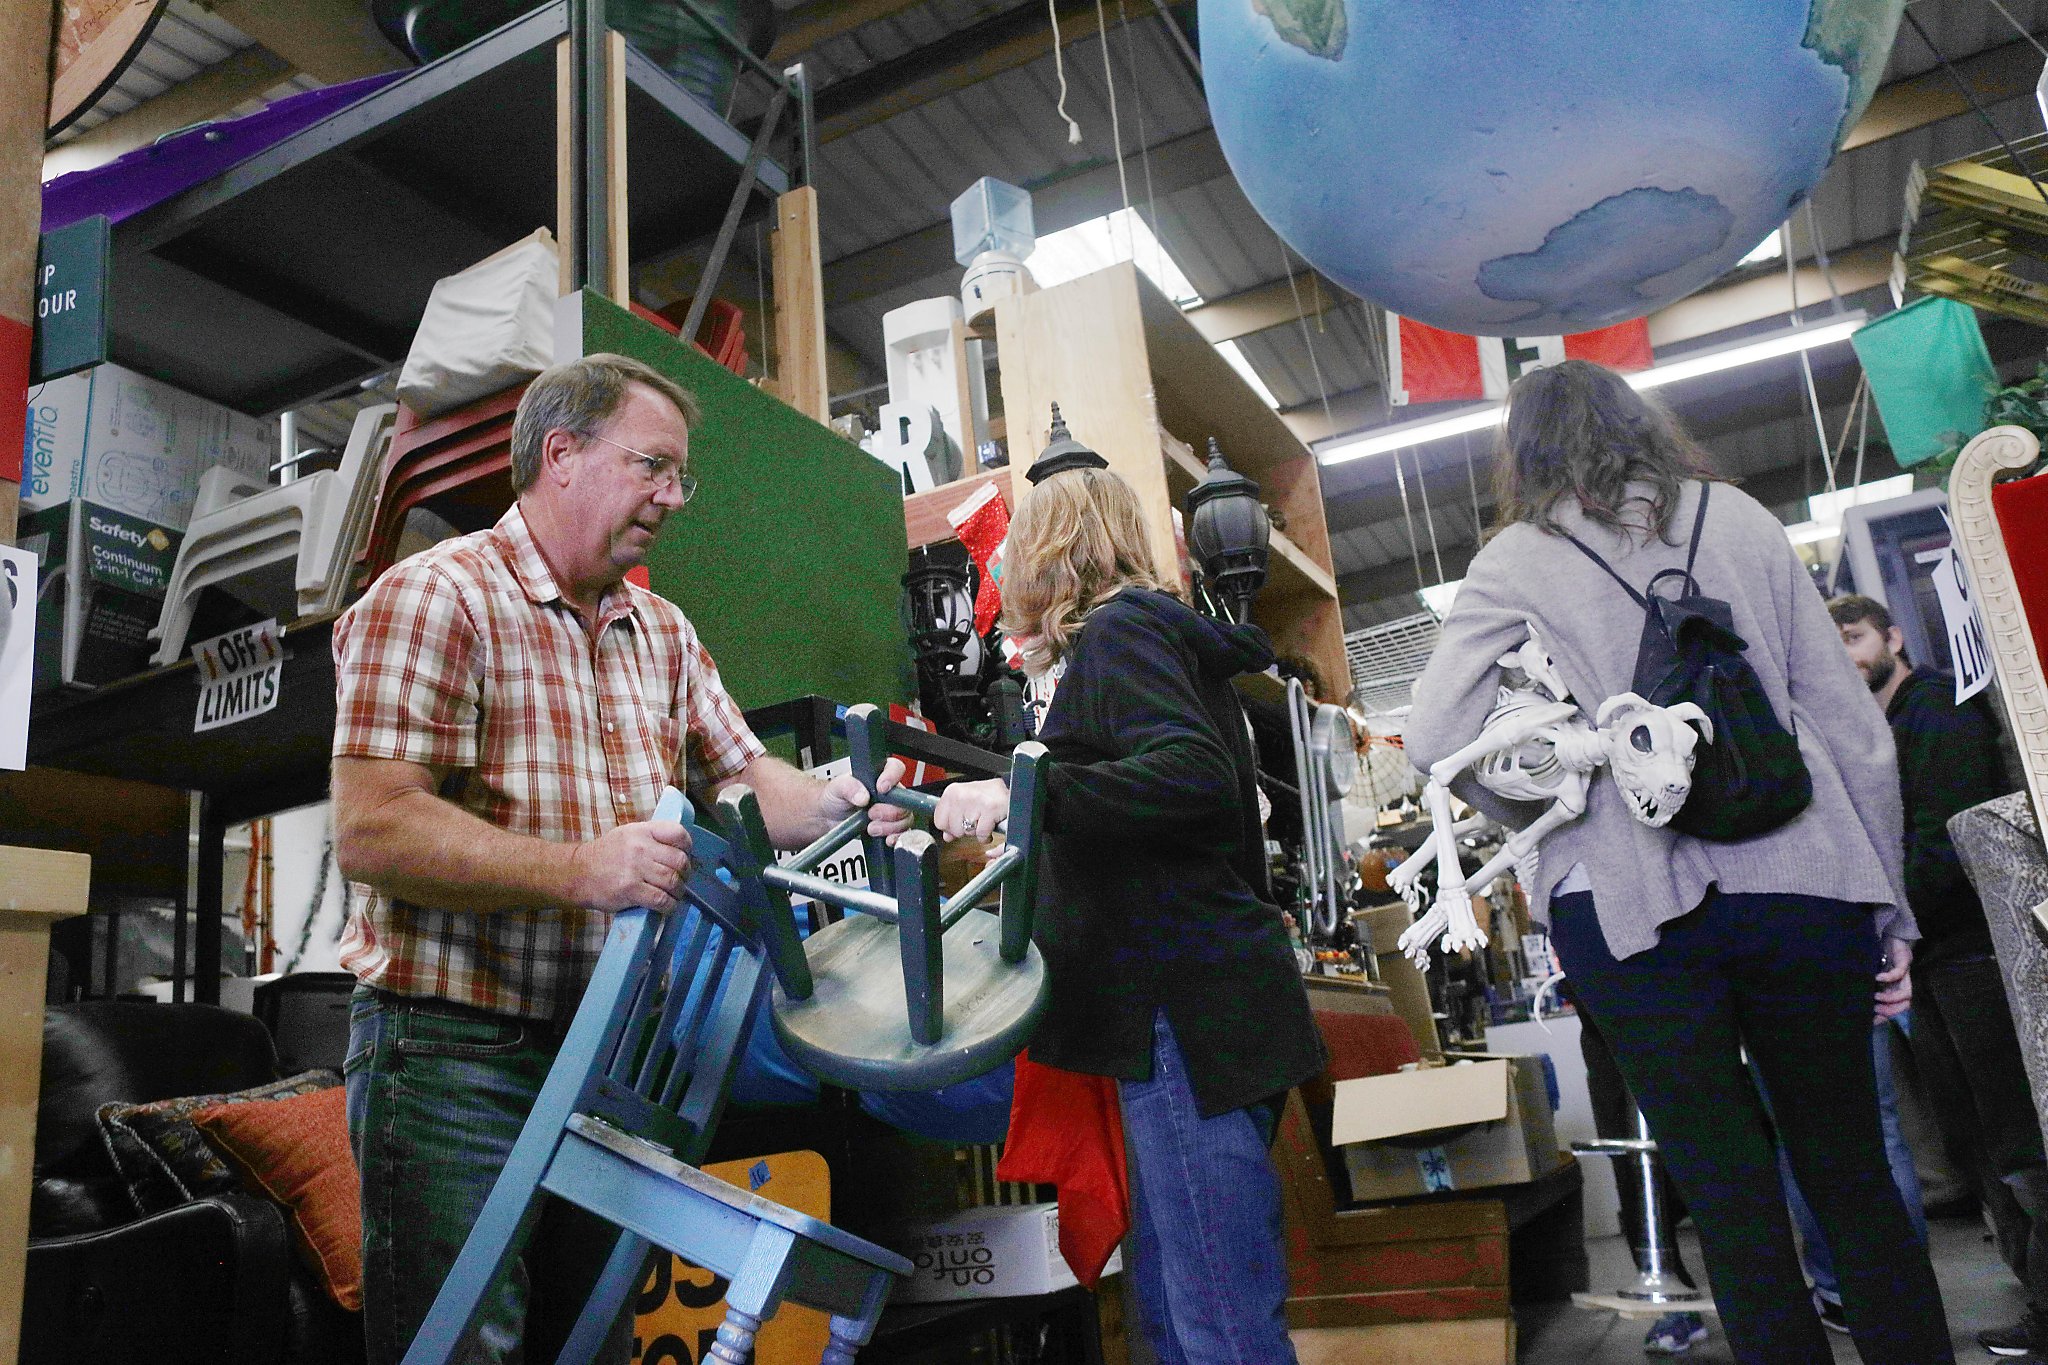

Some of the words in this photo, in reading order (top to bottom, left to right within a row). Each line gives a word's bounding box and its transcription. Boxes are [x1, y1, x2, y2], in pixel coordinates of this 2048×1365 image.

[38, 264, 56, 286] P
[32, 405, 59, 495] evenflo
[89, 516, 147, 548] Safety
[93, 544, 163, 577] Continuum
[218, 629, 257, 674] OFF
[202, 666, 276, 724] LIMITS
